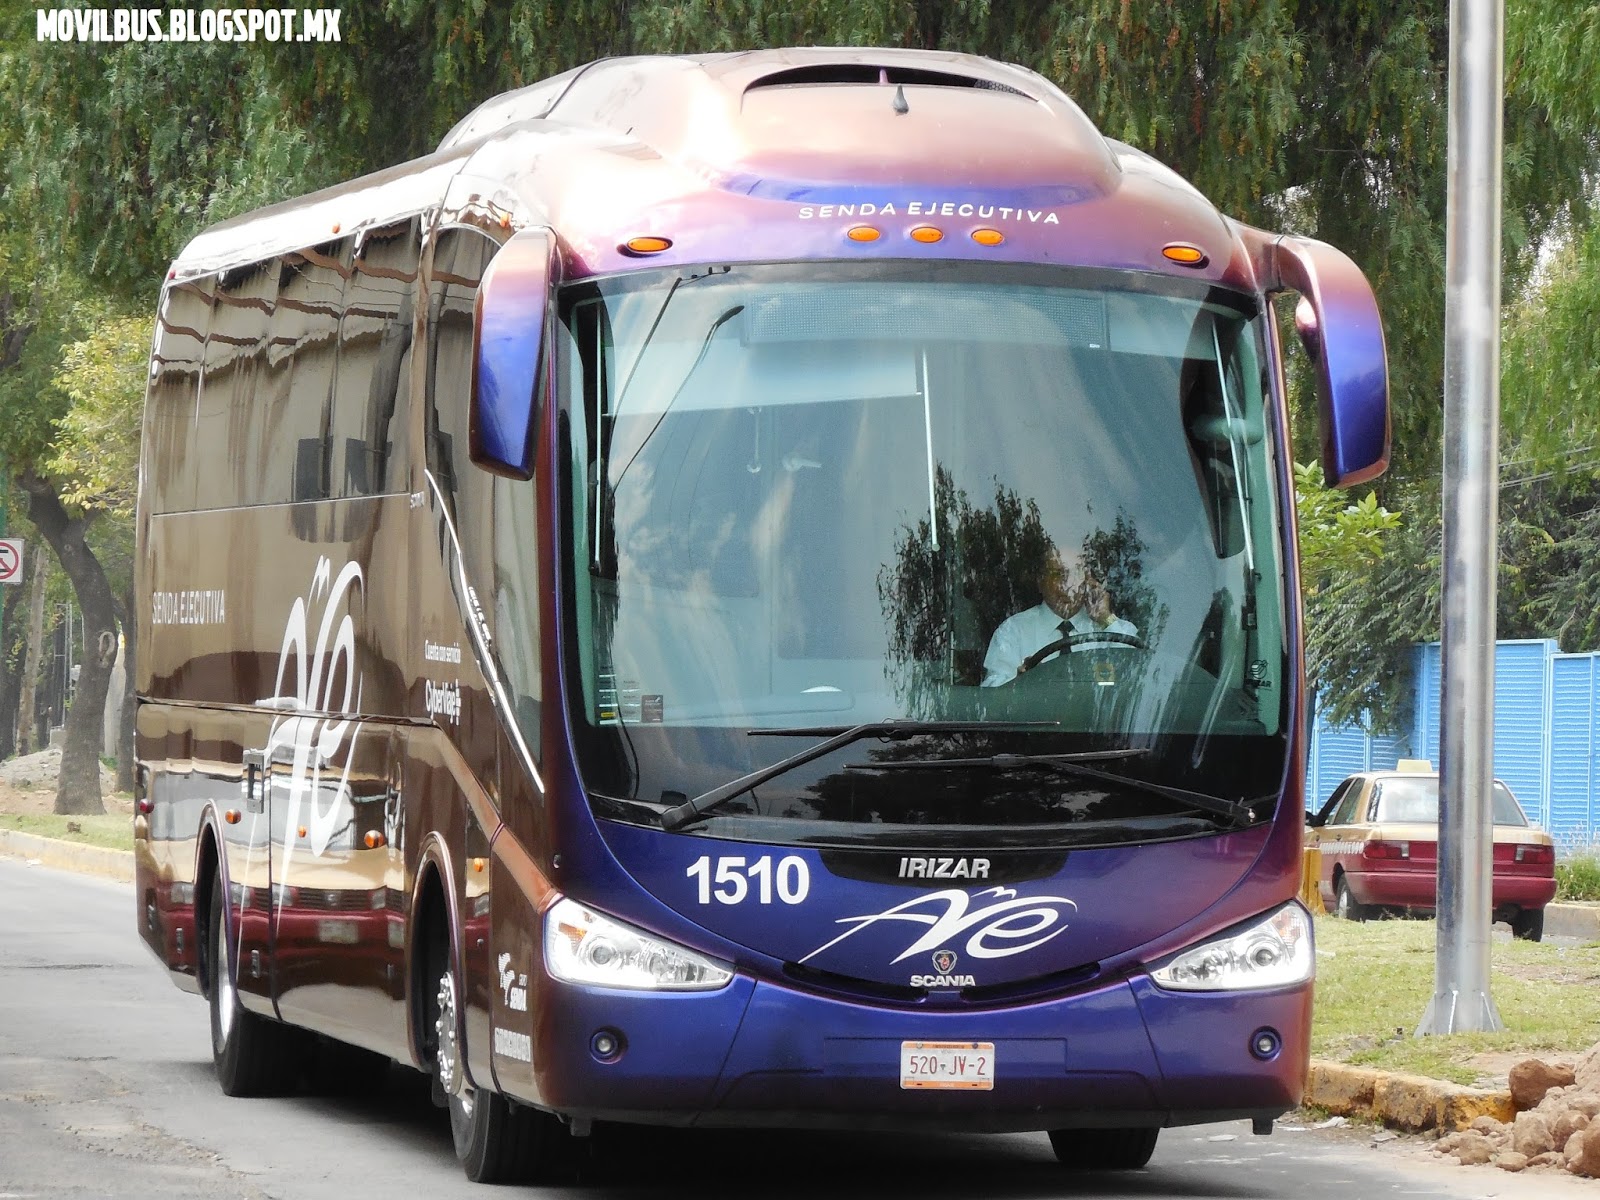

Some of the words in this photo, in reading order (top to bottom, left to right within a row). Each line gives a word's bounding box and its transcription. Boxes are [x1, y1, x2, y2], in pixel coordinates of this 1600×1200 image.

[798, 202, 897, 219] SENDA
[907, 201, 1061, 225] EJECUTIVA
[152, 591, 178, 624] SENDA
[180, 589, 226, 624] EJECUTIVA
[686, 855, 811, 905] 1510
[898, 857, 992, 879] IRIZAR
[909, 974, 977, 988] SCANIA
